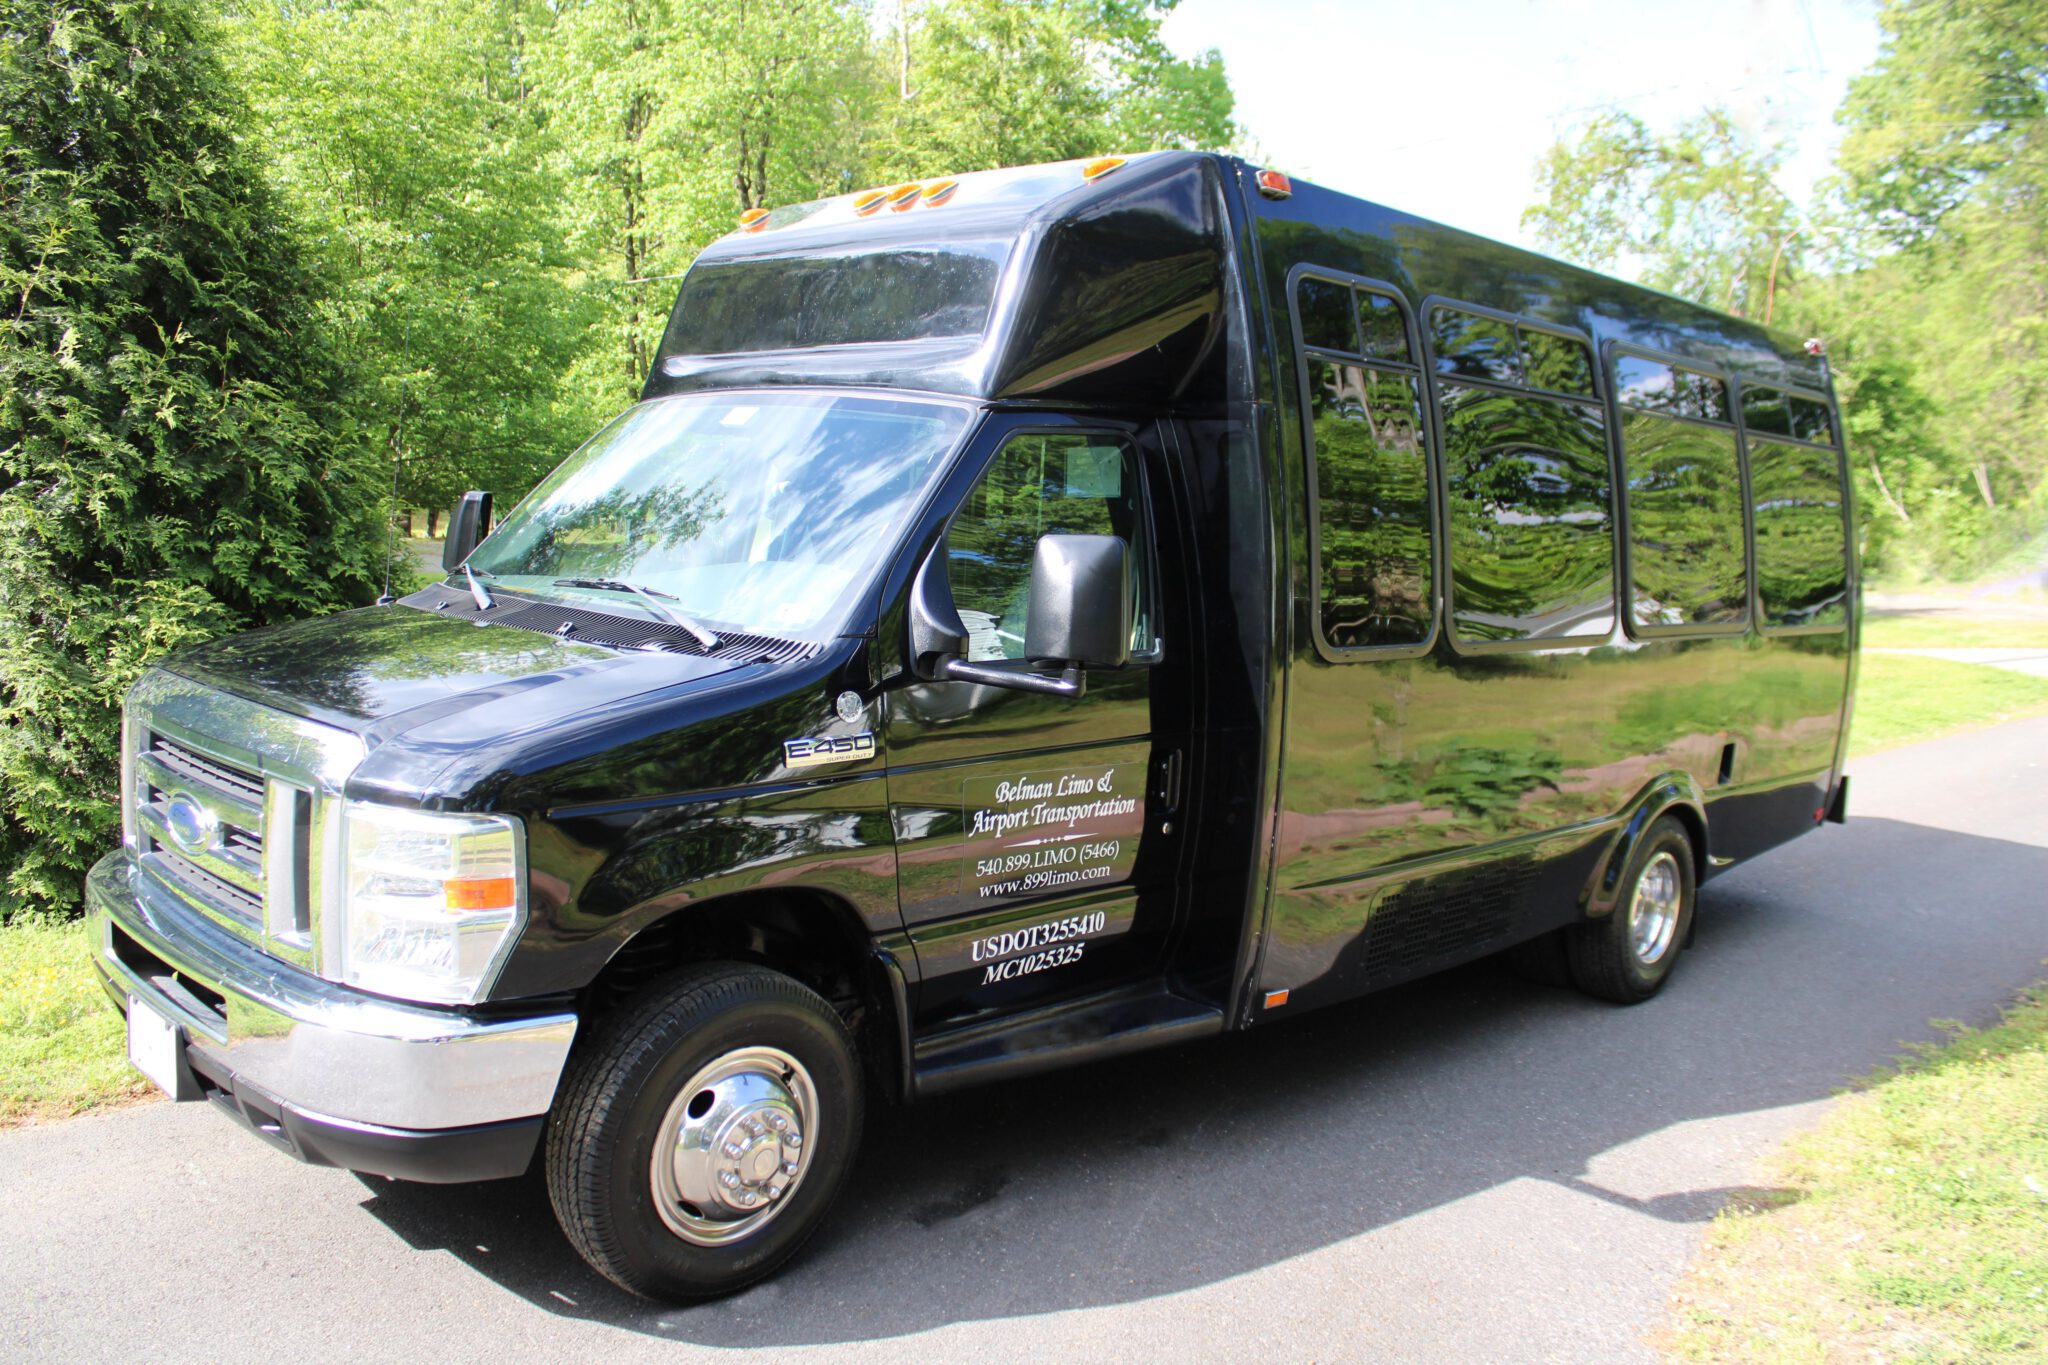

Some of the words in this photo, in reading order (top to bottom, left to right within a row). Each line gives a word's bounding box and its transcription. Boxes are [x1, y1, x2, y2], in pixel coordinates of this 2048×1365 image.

[852, 753, 872, 761] DUTY
[995, 777, 1053, 804] Belman
[1056, 774, 1093, 797] Limo
[1097, 769, 1114, 793] &
[968, 810, 1029, 838] Airport
[1031, 794, 1136, 828] Transportation
[975, 846, 1076, 877] 540.899.LIMO
[1079, 840, 1120, 865] (5466)
[979, 865, 1111, 898] www.899limo.com
[971, 911, 1105, 962] USDOT3255410
[981, 942, 1085, 985] MC1025325
